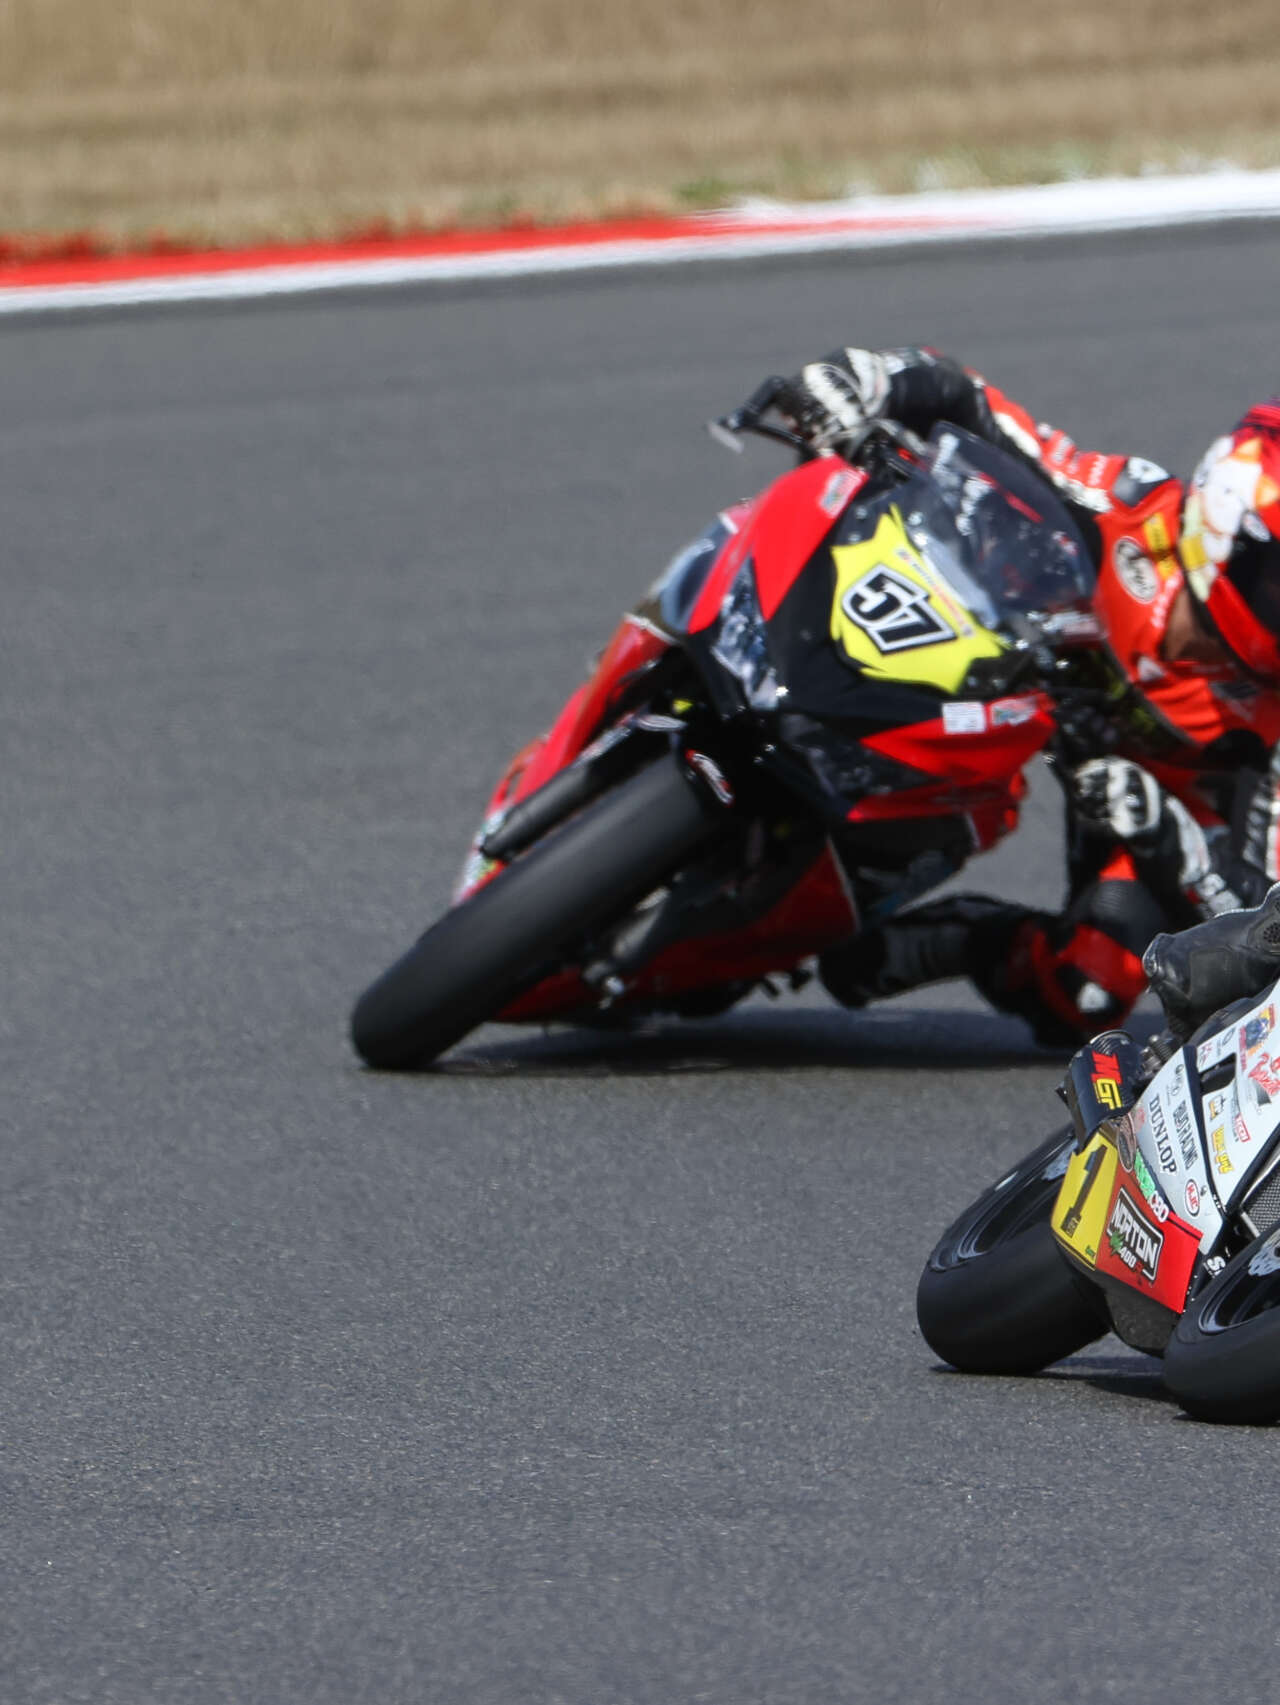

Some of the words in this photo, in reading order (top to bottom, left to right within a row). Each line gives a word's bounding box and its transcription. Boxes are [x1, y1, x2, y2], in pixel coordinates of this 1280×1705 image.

[846, 569, 949, 648] 57
[1149, 1094, 1178, 1174] DUNLOP
[1060, 1144, 1108, 1239] 1
[1111, 1198, 1159, 1269] NORTON
